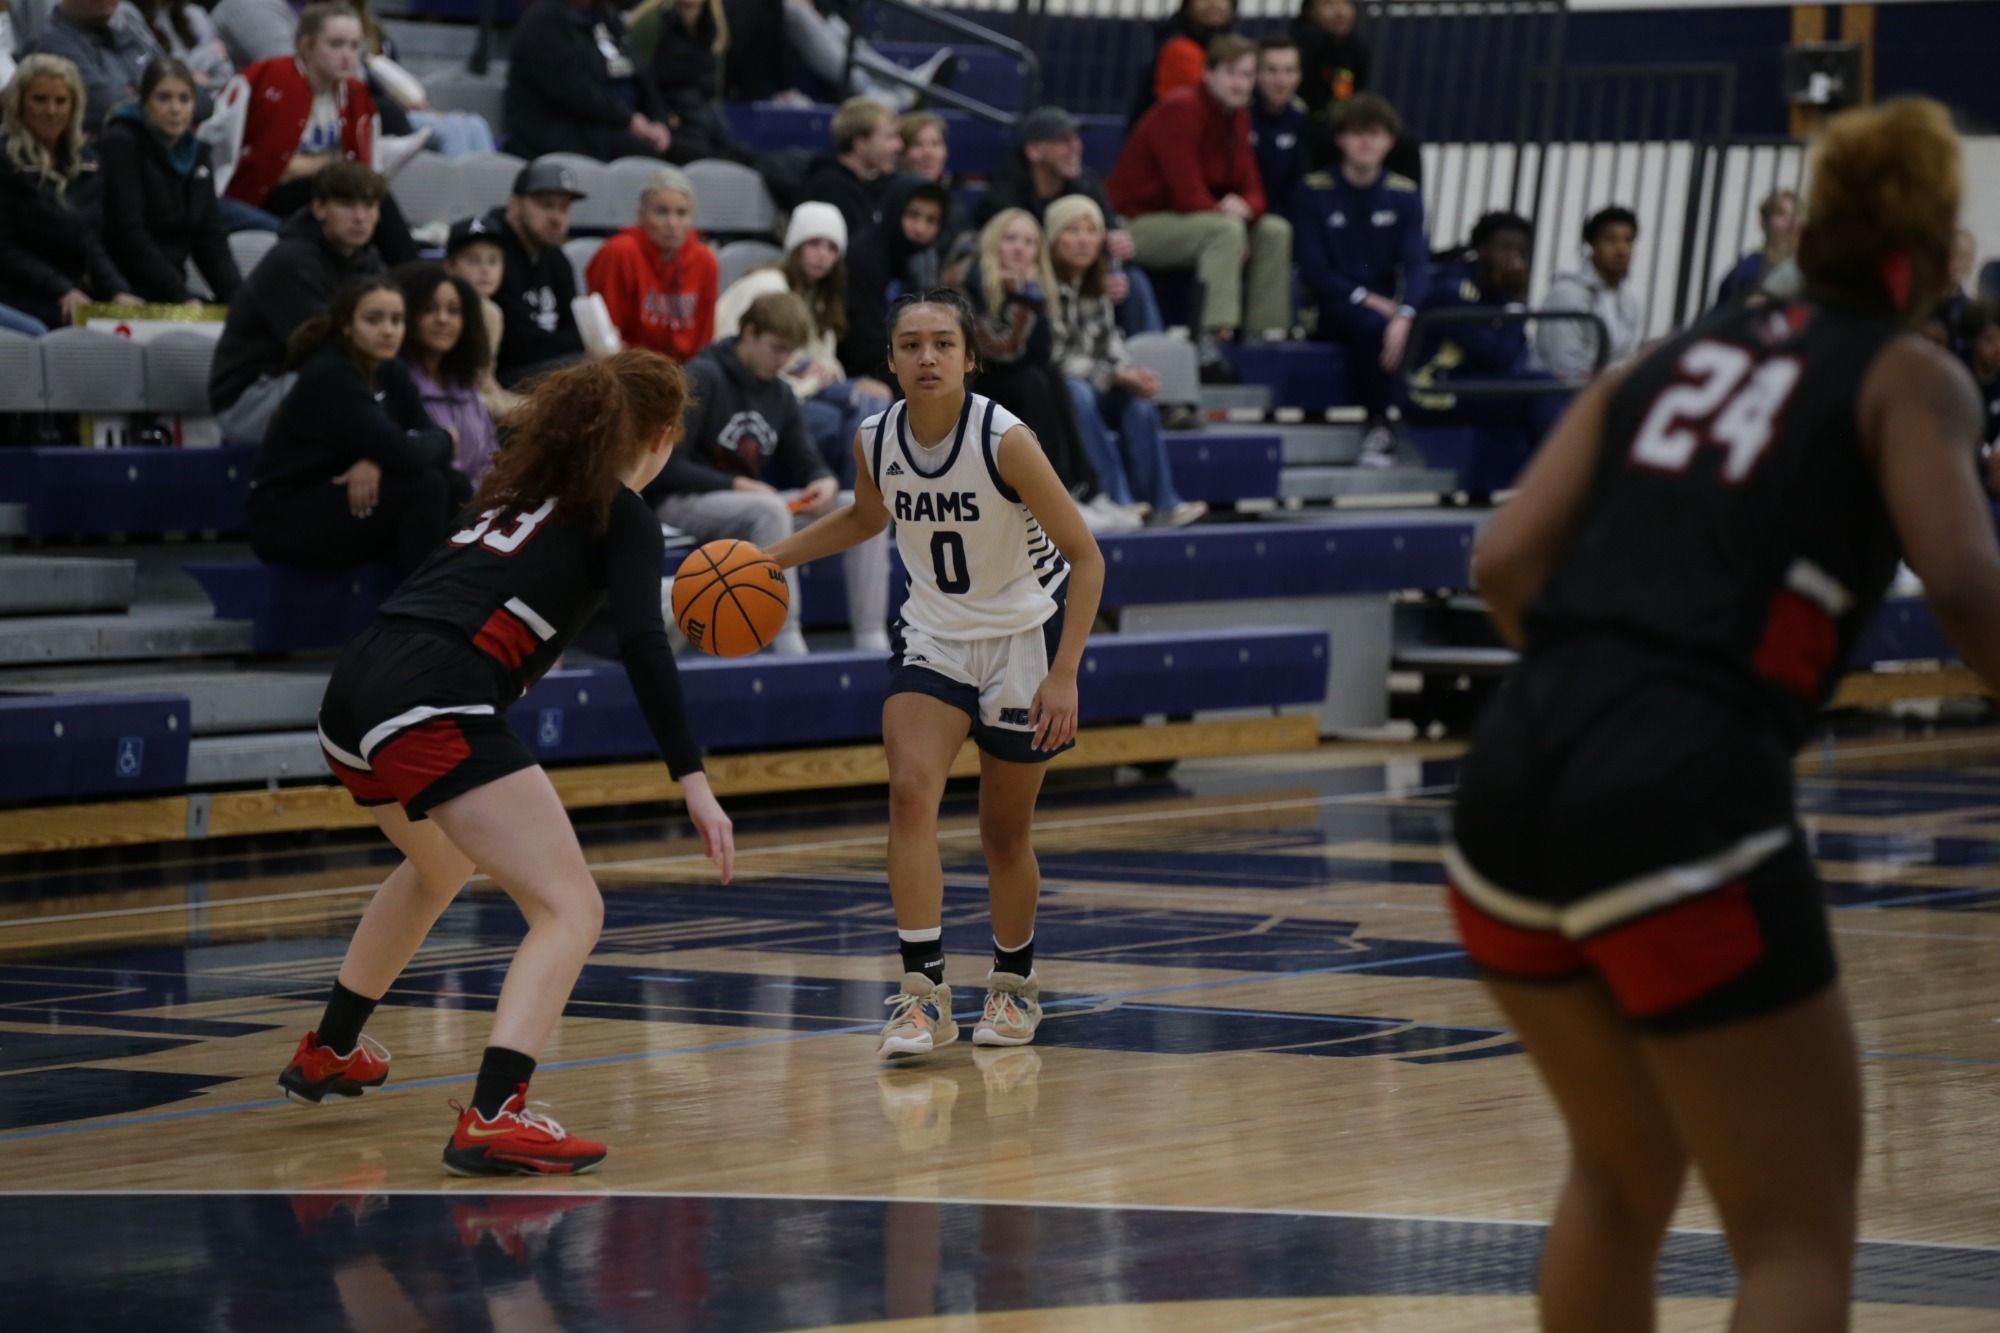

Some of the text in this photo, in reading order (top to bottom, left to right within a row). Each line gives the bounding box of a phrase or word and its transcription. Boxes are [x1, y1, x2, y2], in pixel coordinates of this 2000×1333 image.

[1629, 336, 1807, 487] 24
[895, 490, 980, 522] RAMS
[930, 531, 970, 594] 0
